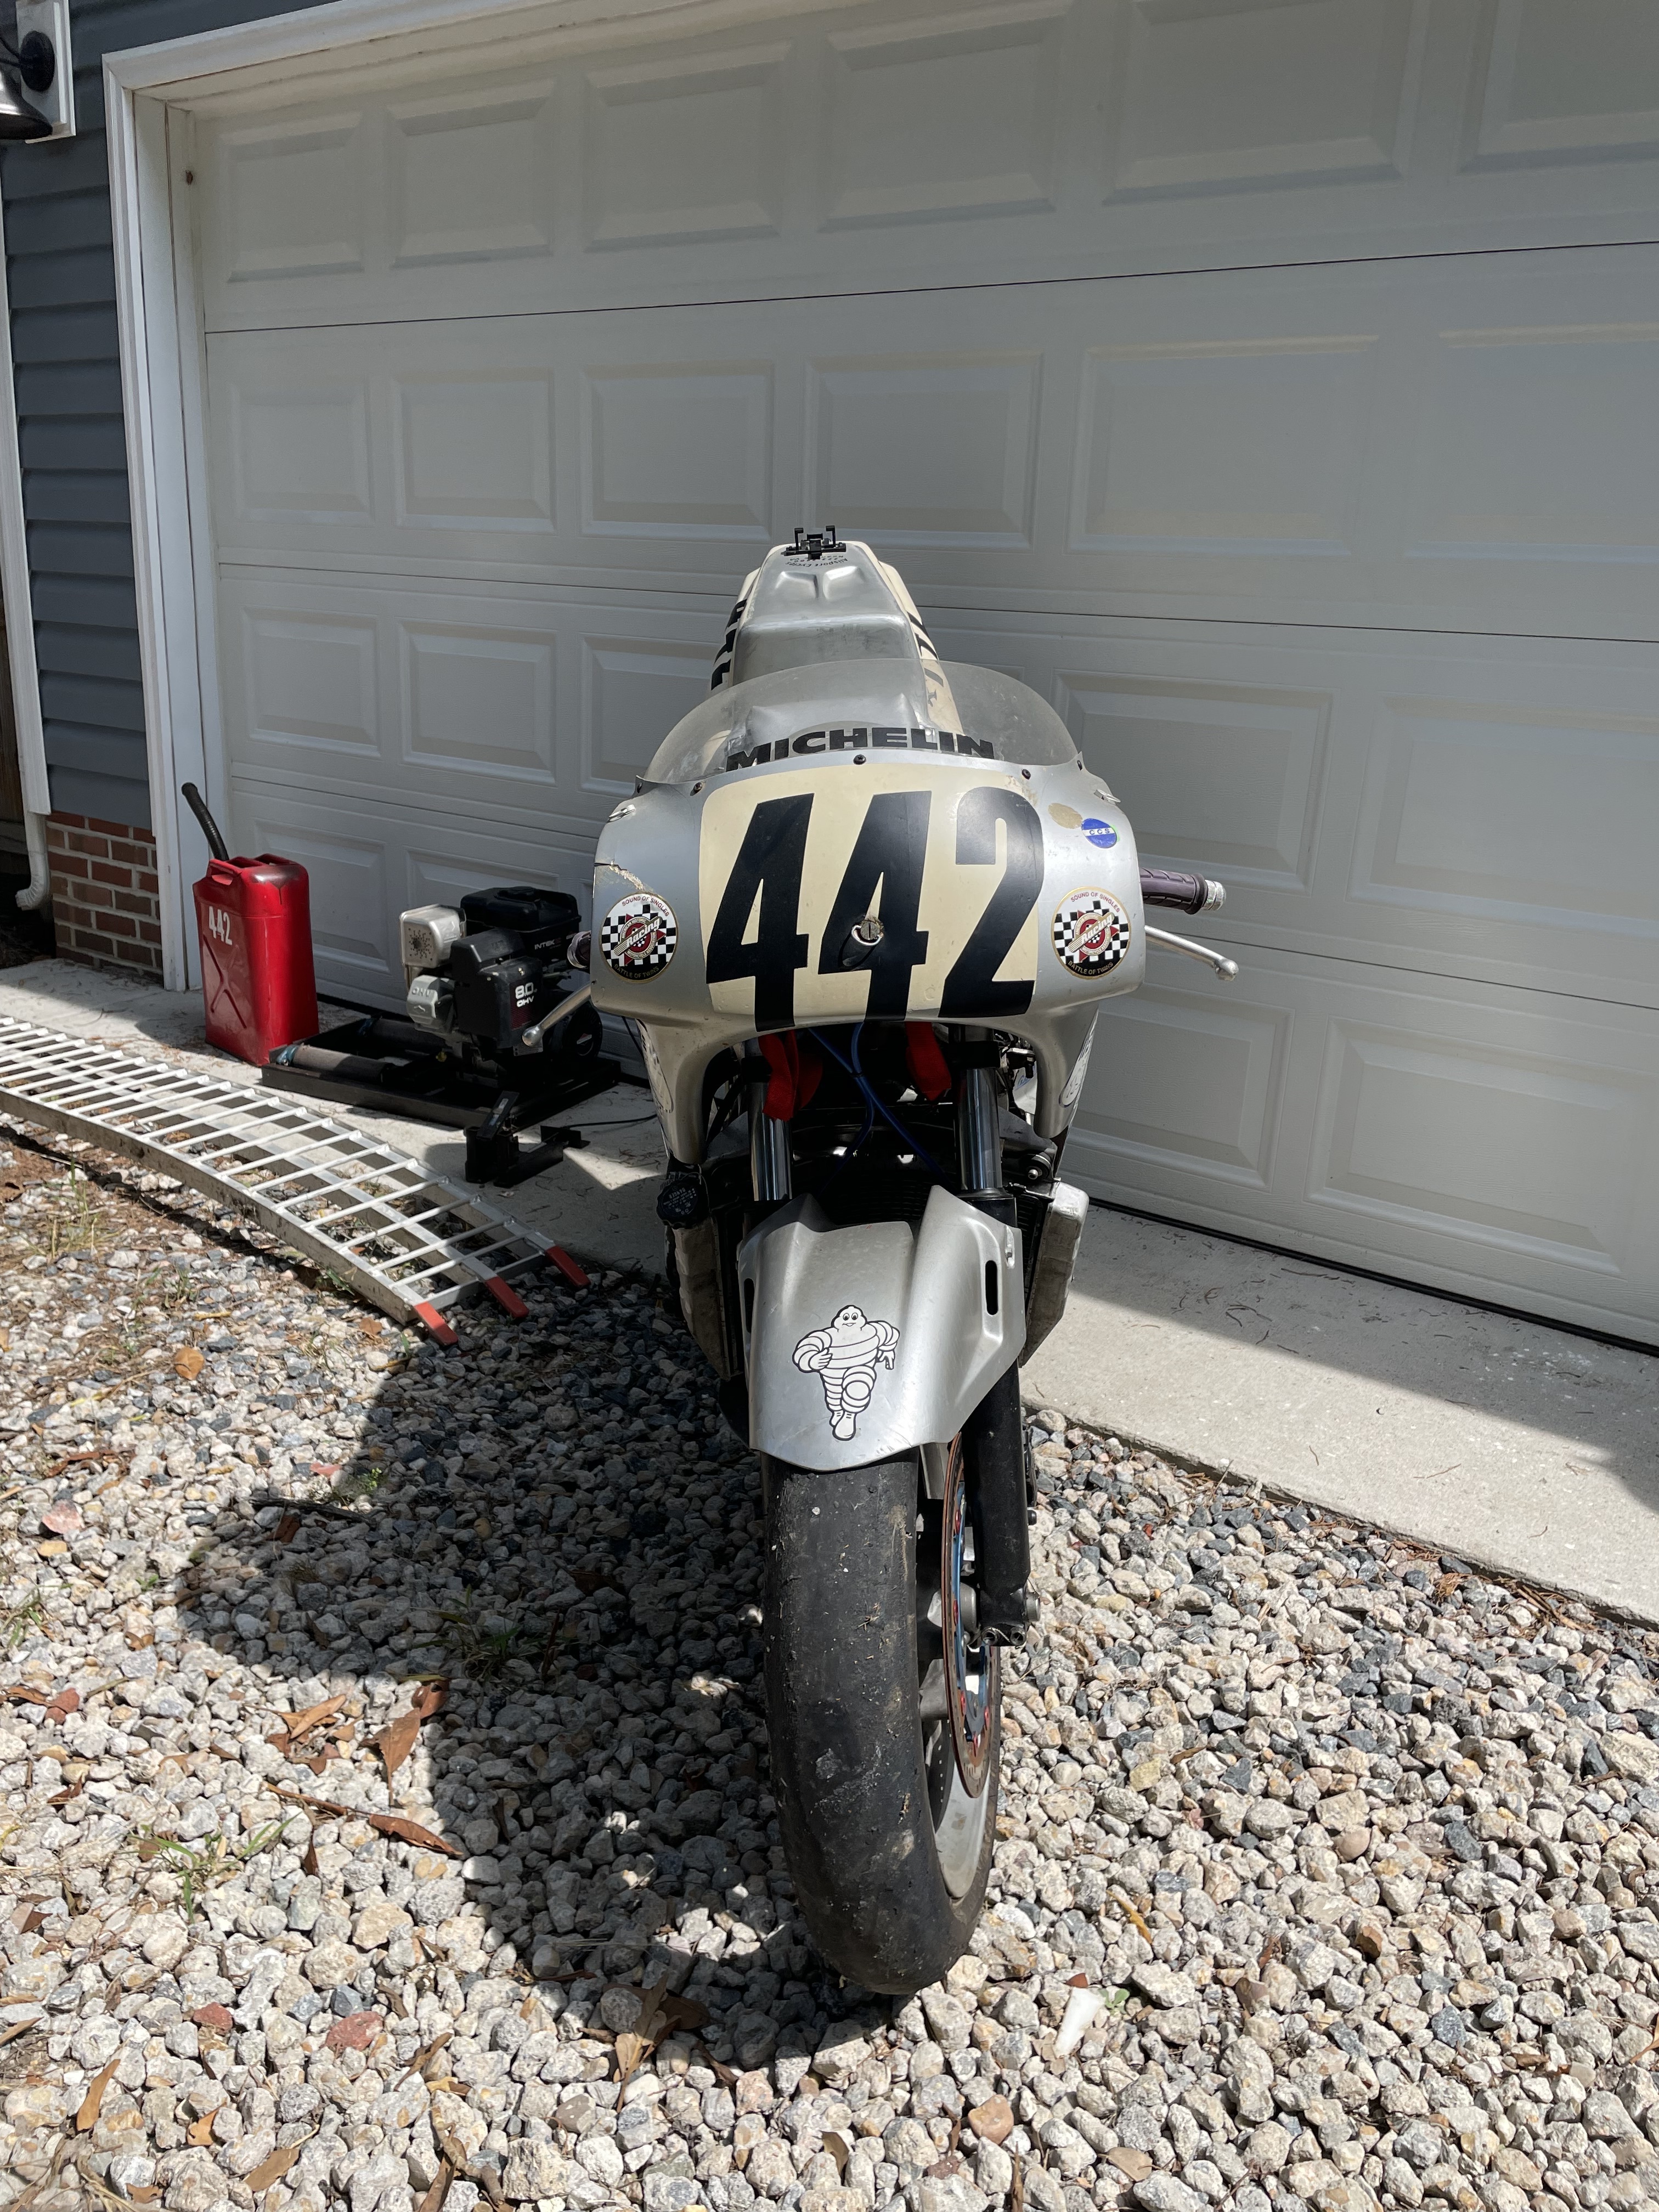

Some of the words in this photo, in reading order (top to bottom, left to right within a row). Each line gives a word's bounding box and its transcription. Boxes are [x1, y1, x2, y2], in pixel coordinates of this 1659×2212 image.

[726, 727, 995, 772] MICHELIN
[622, 896, 641, 906] SOUND
[651, 898, 670, 917] SINGLES
[706, 786, 1044, 1032] 442
[1070, 892, 1089, 902] SOUND
[1099, 894, 1120, 913] SINGLES
[208, 906, 233, 946] 442
[627, 918, 661, 947] Racing
[1081, 915, 1113, 943] Racing
[614, 963, 633, 978] BATTLE
[642, 966, 659, 978] TWINS
[1068, 960, 1087, 974] BATTLE
[1097, 962, 1114, 974] TWINS
[515, 982, 534, 1000] 8.0
[517, 995, 534, 1007] OHV
